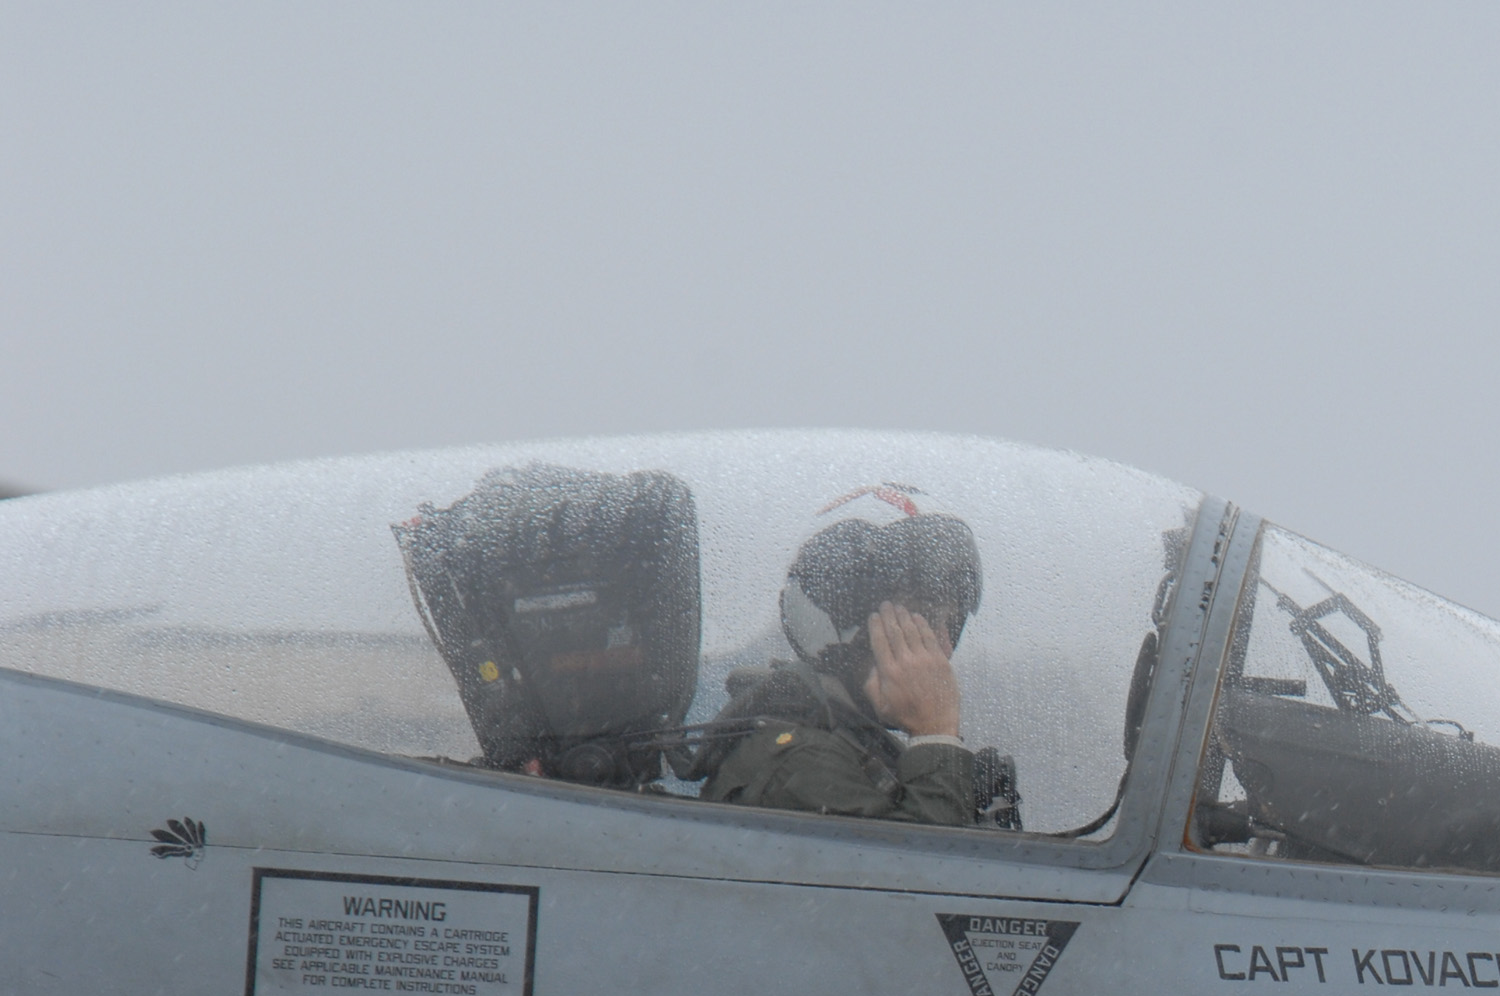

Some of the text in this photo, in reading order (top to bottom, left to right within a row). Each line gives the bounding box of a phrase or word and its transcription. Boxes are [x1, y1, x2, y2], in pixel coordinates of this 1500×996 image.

[343, 896, 447, 921] WARNING
[278, 917, 509, 942] THIS AIRCRAFT CONTAINS A CARTRIDGE
[969, 917, 1048, 936] DANGER
[275, 931, 510, 956] ACTUATED EMERGENCY ESCAPE SYSTEM
[972, 938, 1042, 951] EJECTION SEAT
[284, 945, 499, 969] EQUIPPED WITH EXPLOSIVE CHARGES
[986, 962, 1023, 972] CANOPY
[996, 952, 1016, 961] AND
[1214, 944, 1328, 984] CAPT
[272, 958, 509, 984] SEE APPLICABLE MAINTENANCE MANUAL
[302, 974, 476, 995] FOR COMPLETE INSTRUCTIONS
